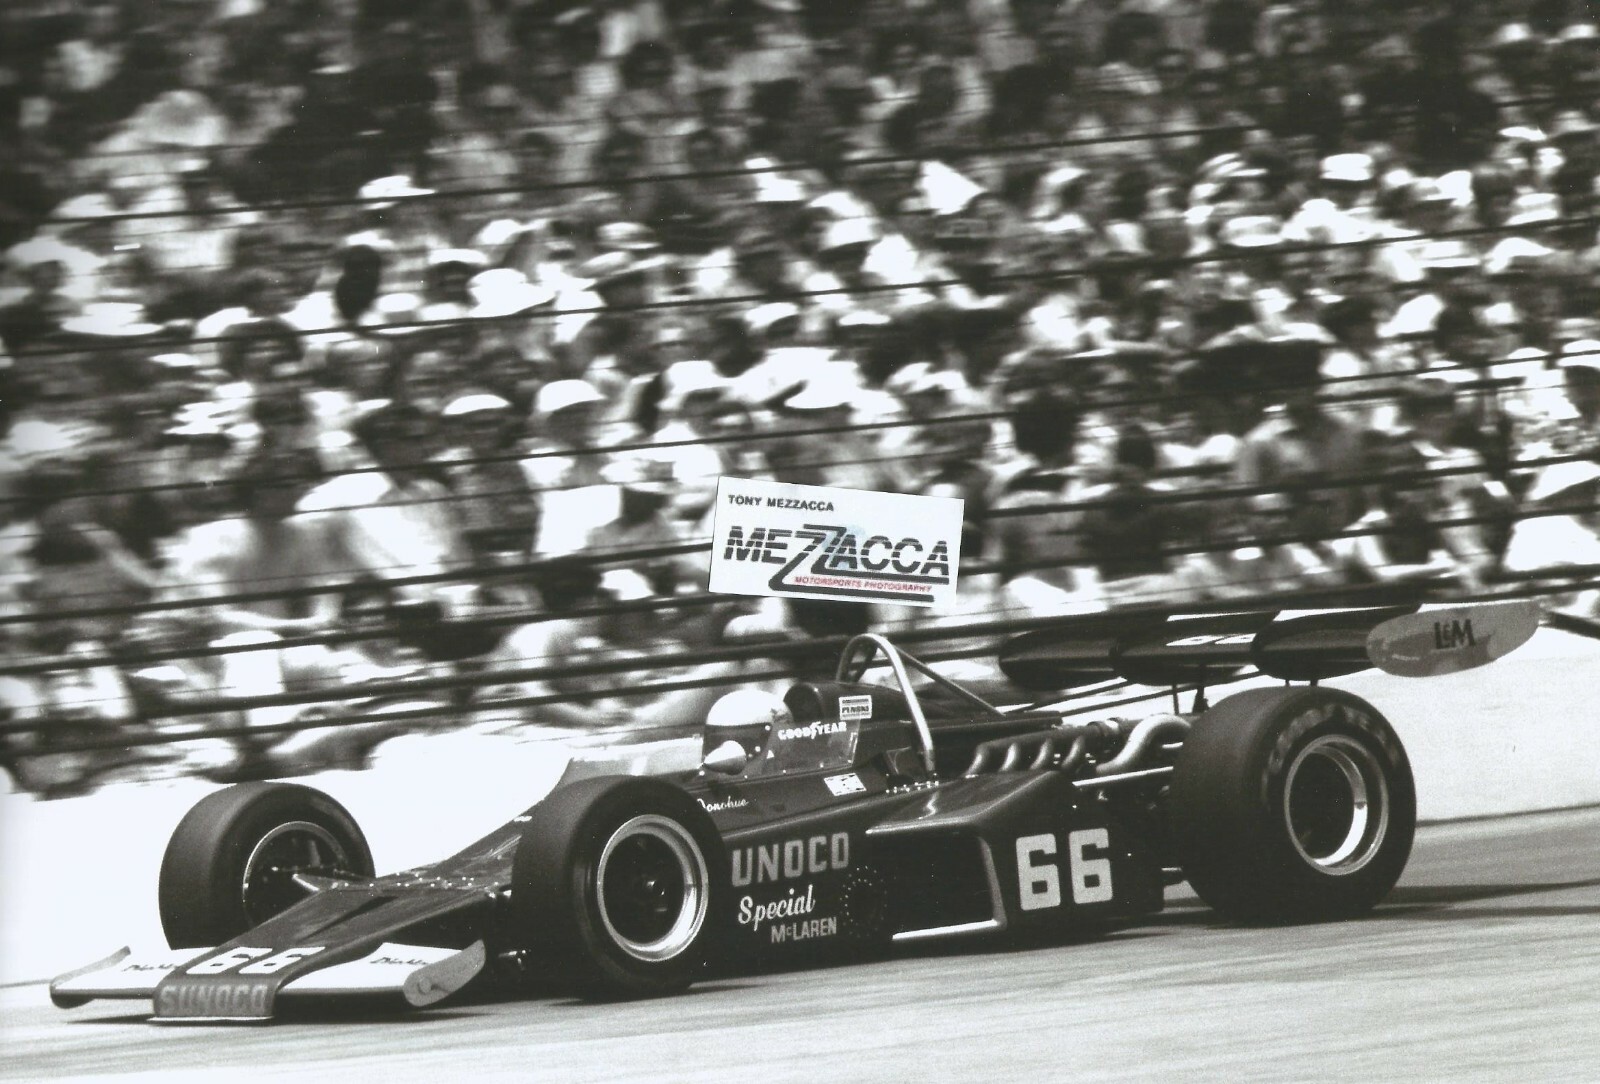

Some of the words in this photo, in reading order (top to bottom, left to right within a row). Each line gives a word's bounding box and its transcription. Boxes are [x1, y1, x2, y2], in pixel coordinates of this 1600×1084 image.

[777, 721, 848, 740] GOODYEAR
[1016, 828, 1113, 911] 66
[737, 884, 816, 932] Special
[771, 917, 837, 944] McLAREN
[185, 946, 326, 975] 66
[160, 983, 269, 1017] SUNOCO
